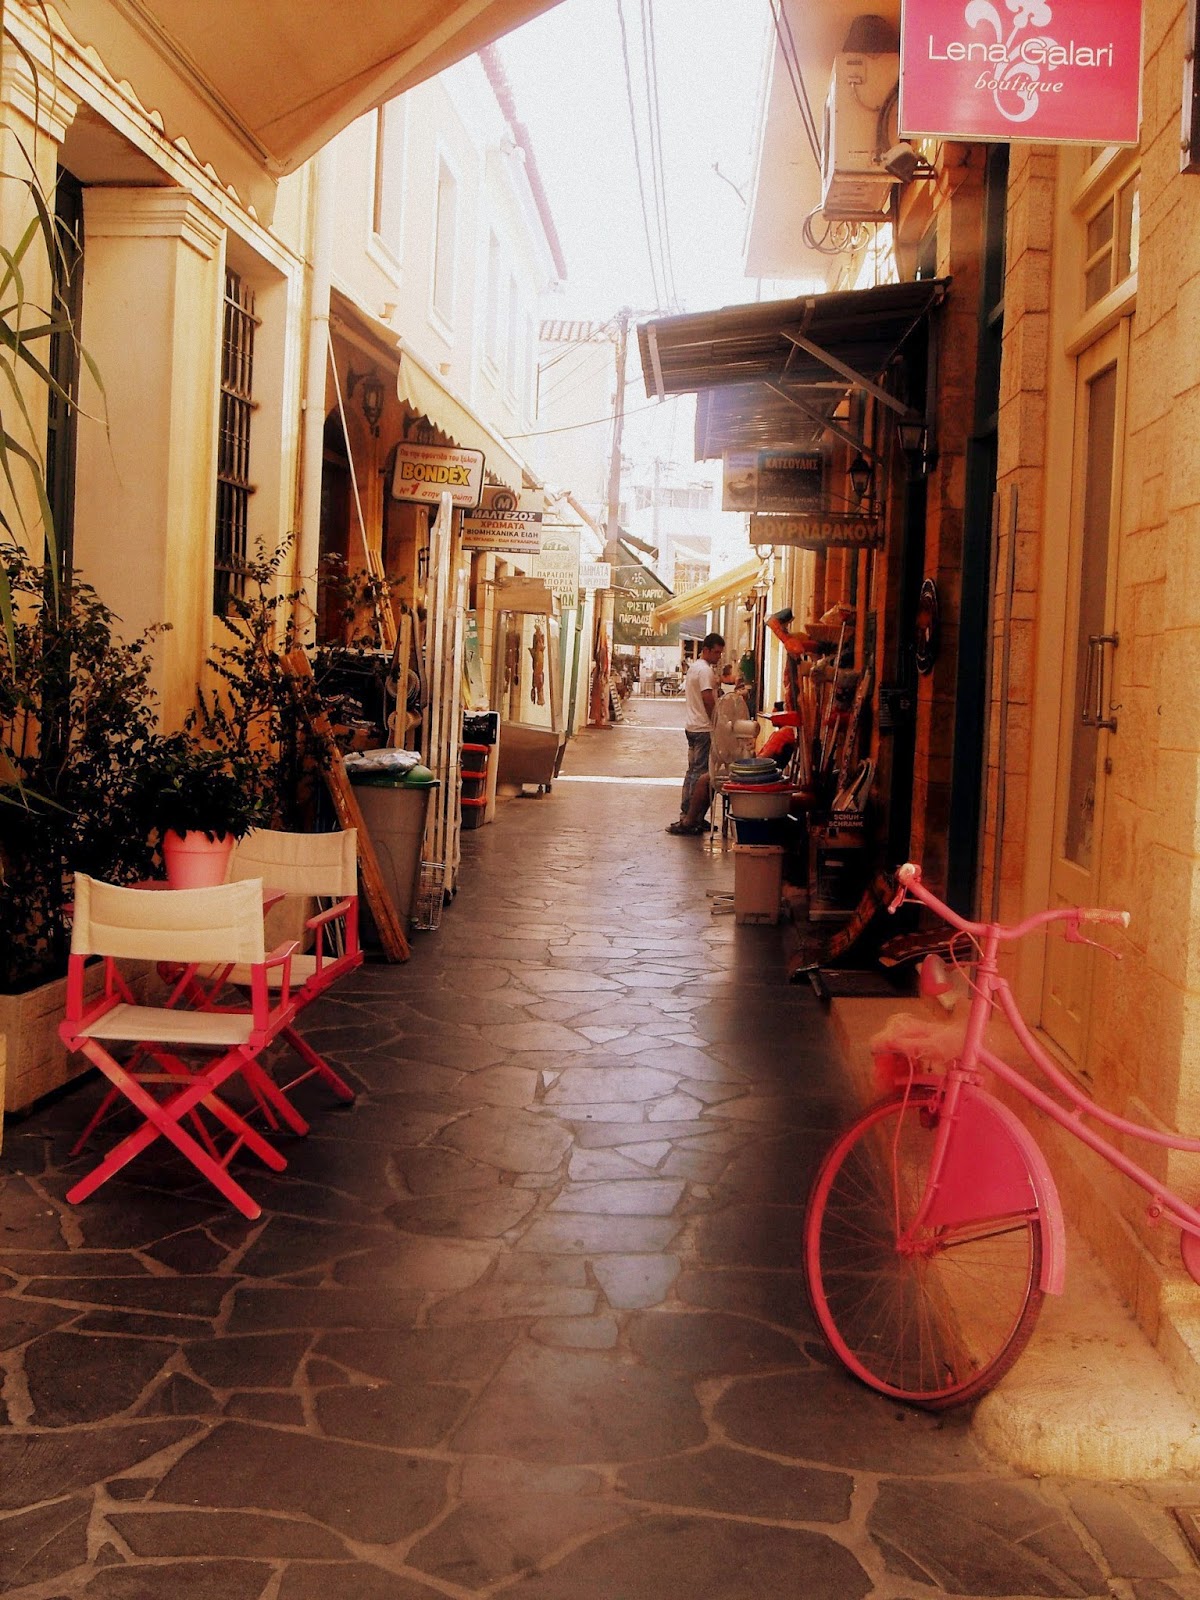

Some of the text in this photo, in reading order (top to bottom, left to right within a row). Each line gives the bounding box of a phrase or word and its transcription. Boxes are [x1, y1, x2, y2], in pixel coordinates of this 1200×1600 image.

[928, 34, 1113, 68] Lena Galari
[974, 70, 1064, 100] boutique
[401, 461, 471, 486] BONDEX
[410, 482, 420, 495] 1
[421, 489, 440, 499] στην
[471, 509, 536, 522] ΜΑΛΤΕΖΟΣ
[466, 529, 519, 537] ΒΙΟΜΗΧΑΝΙΚΑ
[480, 521, 525, 530] ΧΡΩΜΑΤΑ
